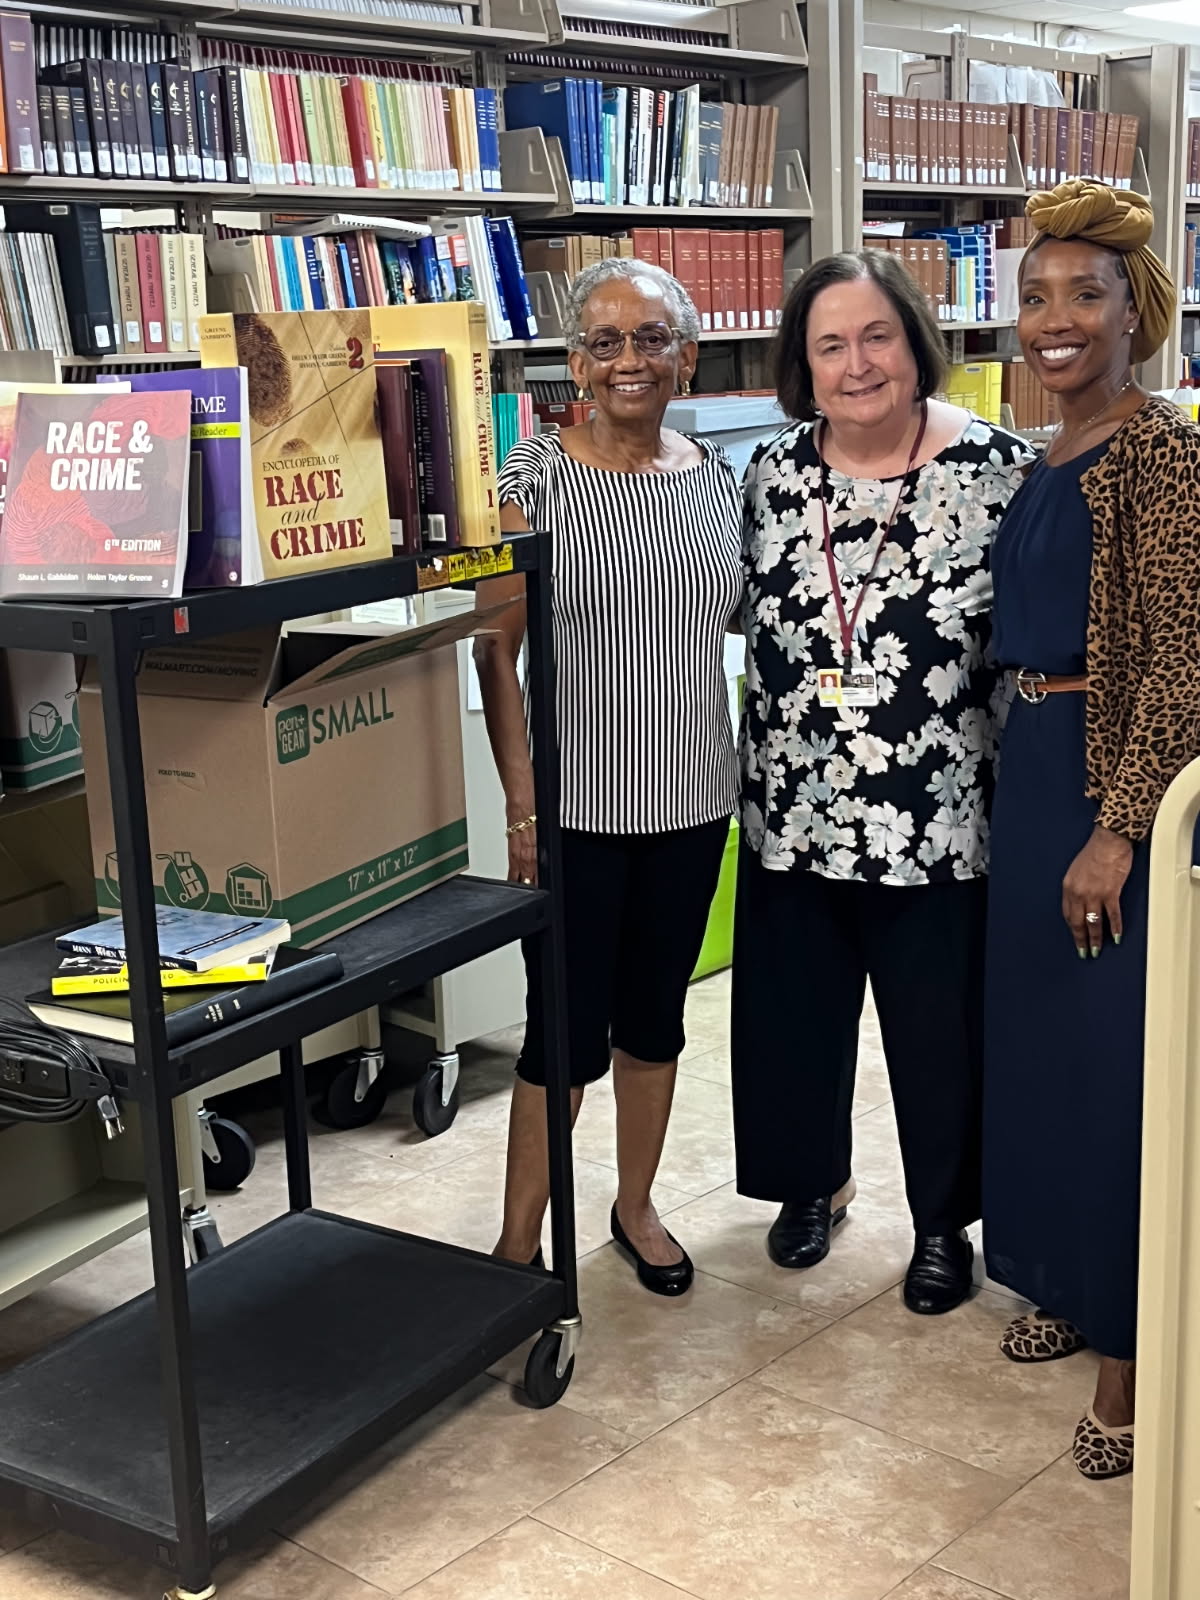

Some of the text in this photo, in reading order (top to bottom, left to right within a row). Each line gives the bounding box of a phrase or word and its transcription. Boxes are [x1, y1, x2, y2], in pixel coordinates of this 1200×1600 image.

[346, 336, 364, 369] 2
[472, 352, 485, 396] RACE
[191, 396, 227, 414] IME
[46, 420, 153, 454] RACE &
[477, 423, 490, 477] CRIME
[51, 457, 145, 491] CRIME
[262, 454, 341, 472] ENCYCLOPEDIA OF
[263, 469, 344, 507] RACE
[281, 492, 326, 526] and
[121, 539, 162, 552] EDITION
[270, 518, 366, 560] CRIME
[18, 573, 40, 581] Shaun
[87, 573, 153, 583] Helen Taylor Greene
[312, 687, 395, 744] SMALL
[282, 729, 305, 754] GEAR
[348, 845, 418, 893] 17" x 11" x 12"
[93, 976, 129, 984] POLICIN
